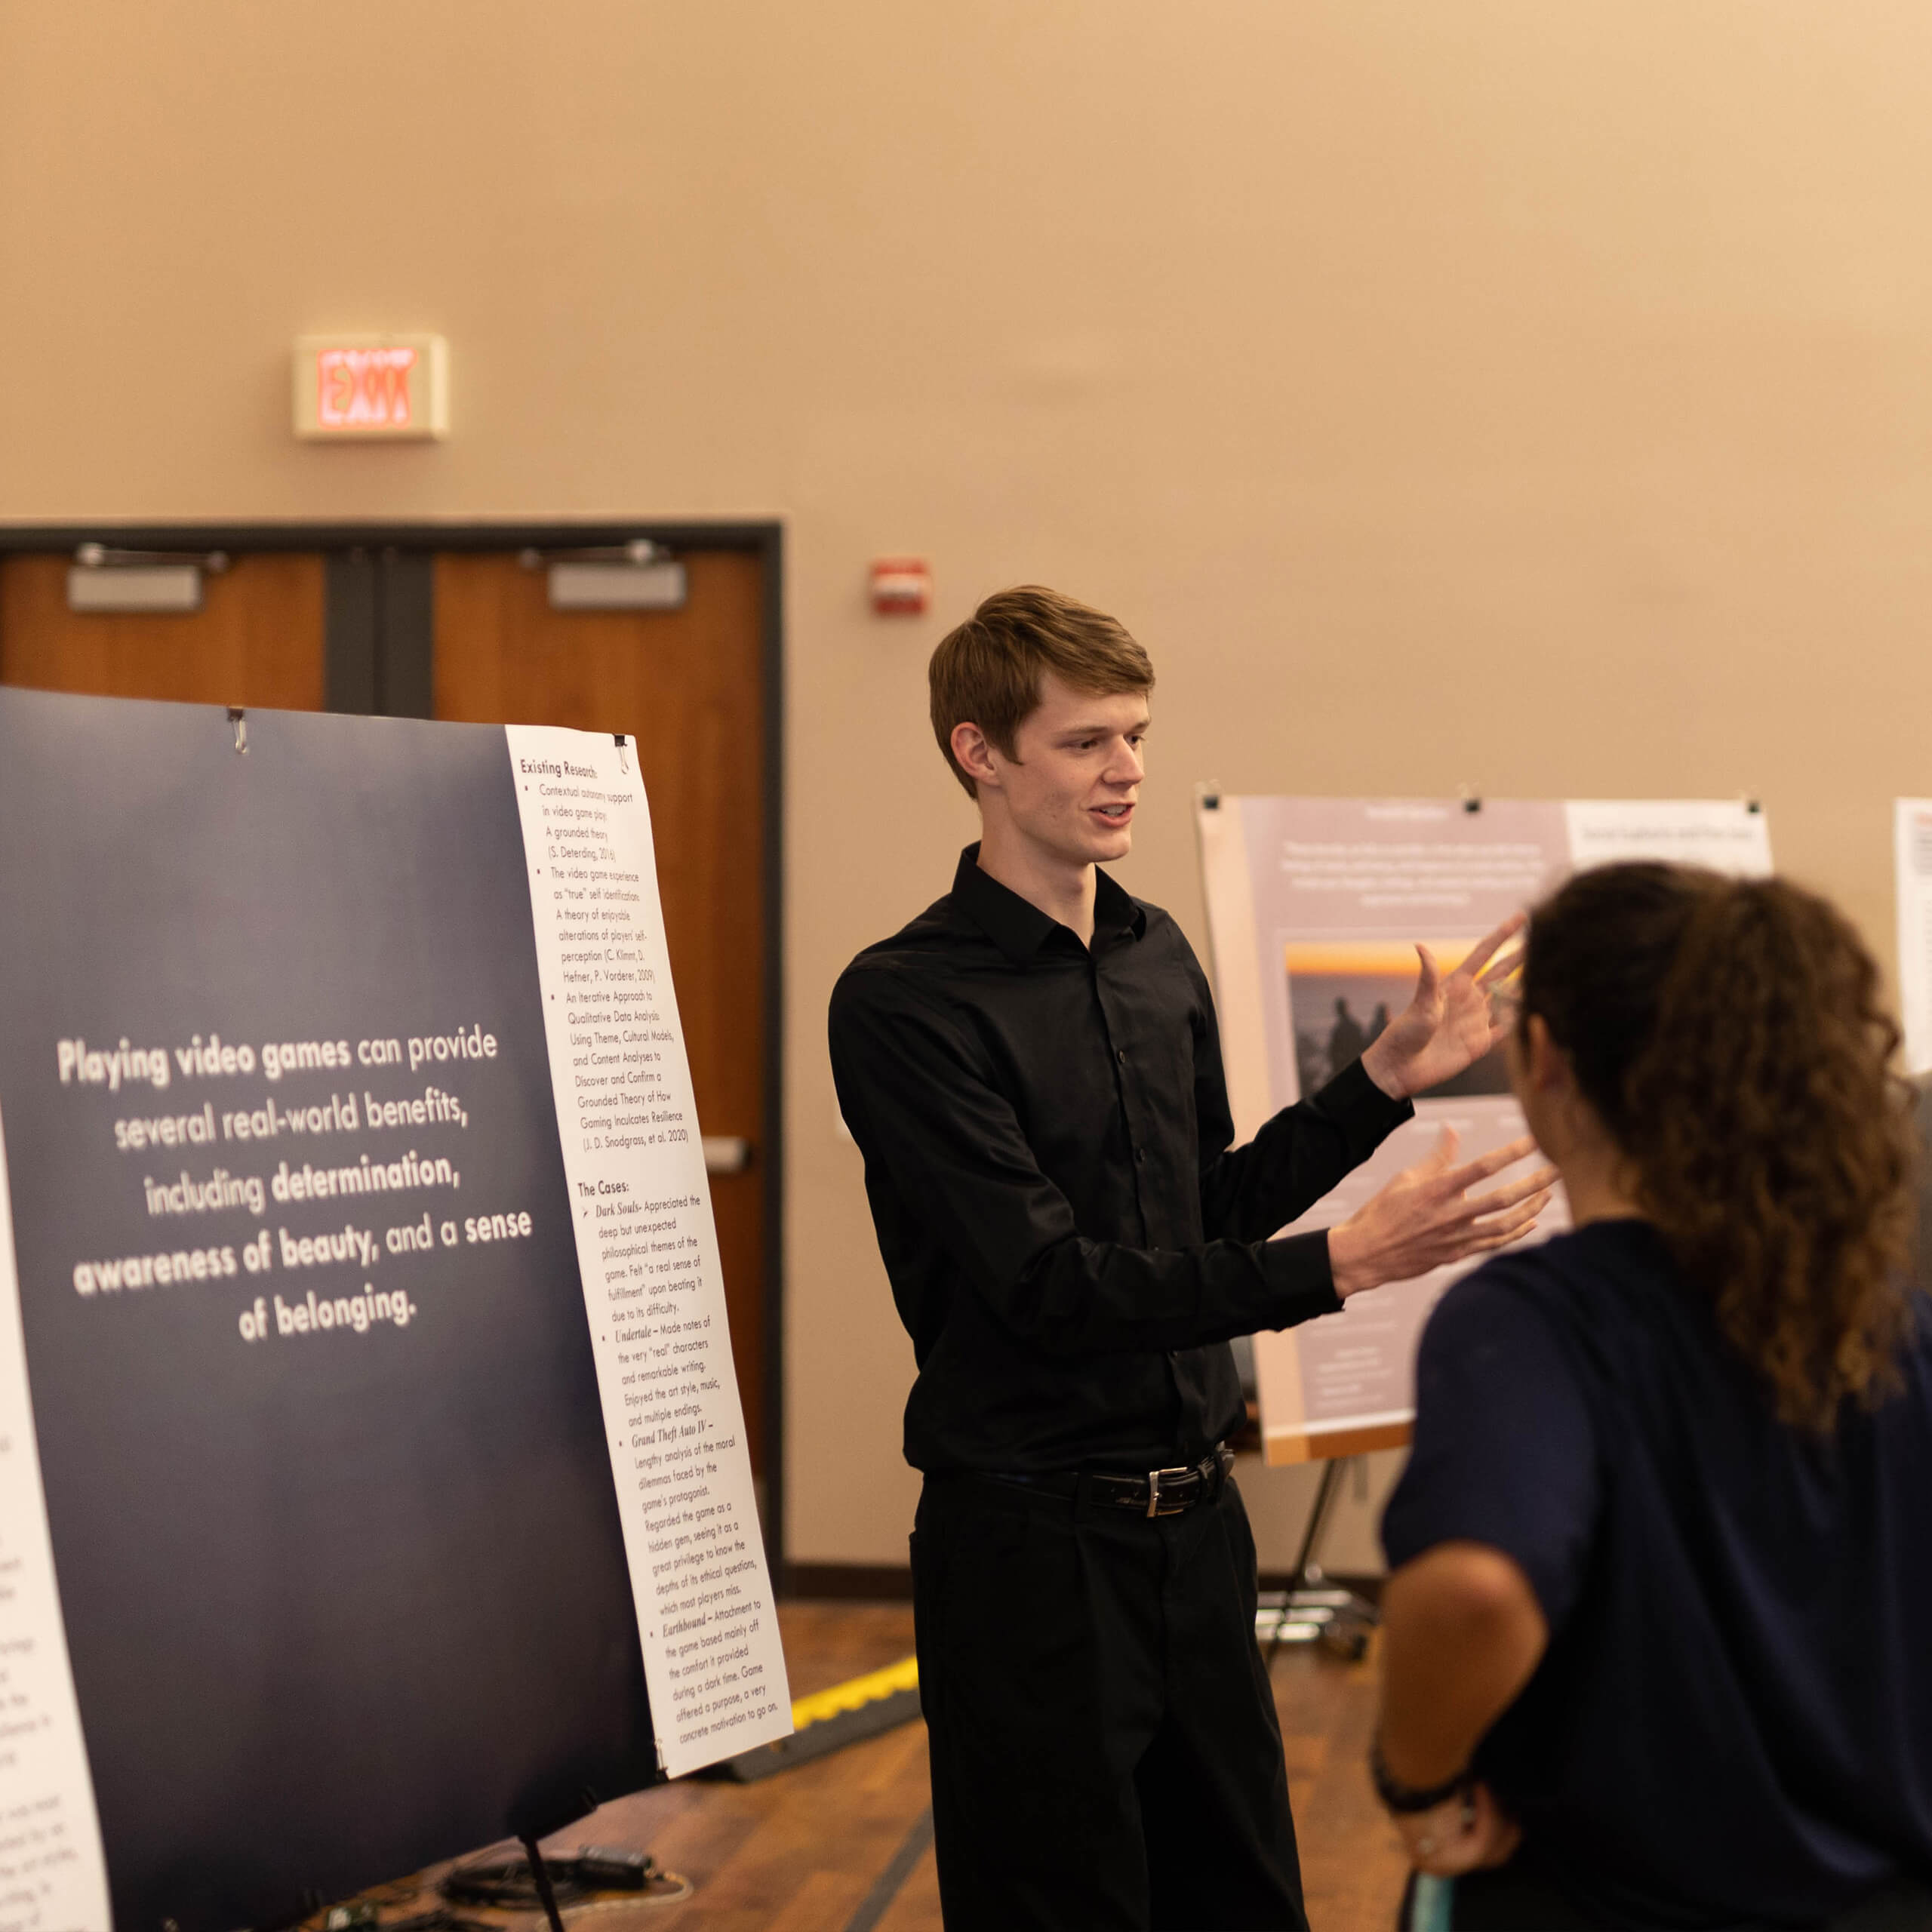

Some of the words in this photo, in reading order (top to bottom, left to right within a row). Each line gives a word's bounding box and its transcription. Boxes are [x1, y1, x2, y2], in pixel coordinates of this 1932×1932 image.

[317, 347, 418, 429] EXIT
[521, 759, 561, 777] Existing
[540, 783, 580, 797] Contextual
[608, 793, 633, 805] support
[552, 805, 573, 817] video
[575, 810, 592, 820] game
[546, 826, 552, 837] A
[555, 826, 589, 840] grounded
[551, 867, 565, 878] The
[568, 868, 588, 878] video
[590, 871, 608, 881] game
[589, 888, 601, 900] self
[556, 909, 562, 920] A
[565, 909, 589, 922] theory
[559, 930, 598, 941] alterations
[561, 950, 602, 964] perception
[567, 993, 576, 1003] An
[579, 991, 610, 1002] Iterative
[568, 1012, 611, 1024] Qualitative
[614, 1011, 632, 1022] Data
[570, 1033, 592, 1047] Using
[623, 1029, 649, 1042] Cultural
[58, 1037, 170, 1091] Playing
[175, 1034, 255, 1077] video
[262, 1039, 352, 1081] games
[358, 1037, 402, 1065] can
[408, 1024, 498, 1071] provide
[573, 1054, 588, 1066] and
[591, 1053, 620, 1065] Content
[623, 1051, 653, 1064] Analyses
[575, 1075, 608, 1087] Discover
[611, 1072, 625, 1084] and
[627, 1070, 655, 1083] Confirm
[577, 1094, 618, 1108] Grounded
[620, 1093, 645, 1106] Theory
[648, 1091, 654, 1103] of
[657, 1091, 671, 1101] How
[115, 1102, 217, 1150] several
[223, 1093, 359, 1140] real-world
[365, 1086, 468, 1129] benefits,
[580, 1115, 611, 1129] Gaming
[614, 1113, 649, 1125] Inculcates
[144, 1168, 266, 1216] including
[271, 1150, 460, 1202] determination,
[578, 1183, 595, 1196] The
[598, 1180, 629, 1195] Cases:
[595, 1204, 615, 1217] Dark
[645, 1195, 688, 1213] Appreciated
[690, 1195, 700, 1205] the
[598, 1226, 618, 1238] deep
[620, 1224, 632, 1236] but
[635, 1217, 676, 1235] unexpected
[72, 1244, 237, 1295] awareness
[243, 1229, 271, 1272] of
[278, 1225, 379, 1266] beauty,
[386, 1212, 434, 1254] and
[441, 1220, 458, 1247] a
[465, 1211, 533, 1244] sense
[651, 1241, 675, 1252] themes
[677, 1236, 685, 1248] of
[687, 1237, 697, 1247] the
[629, 1263, 642, 1277] Felt
[657, 1260, 670, 1273] real
[673, 1260, 691, 1270] sense
[694, 1255, 701, 1267] of
[648, 1283, 666, 1298] upon
[669, 1278, 695, 1291] beating
[238, 1298, 267, 1341] of
[273, 1283, 417, 1335] belonging.
[612, 1309, 625, 1322] due
[615, 1327, 651, 1343] Undertale
[660, 1321, 681, 1335] Made
[683, 1320, 701, 1331] notes
[703, 1315, 711, 1327] of
[632, 1351, 647, 1362] very
[622, 1372, 635, 1385] and
[638, 1365, 678, 1381] remarkable
[624, 1391, 653, 1407] Enjoyed
[669, 1386, 678, 1397] art
[628, 1416, 641, 1427] and
[645, 1410, 671, 1424] multiple
[632, 1428, 655, 1447] Grand
[657, 1426, 677, 1442] Theft
[679, 1423, 696, 1438] Auto
[698, 1420, 706, 1432] IV
[665, 1447, 692, 1462] analysis
[716, 1435, 735, 1450] moral
[673, 1466, 694, 1481] faced
[695, 1465, 704, 1478] by
[645, 1515, 680, 1532] Regarded
[696, 1507, 715, 1521] game
[694, 1526, 716, 1541] seeing
[653, 1561, 672, 1577] great
[674, 1553, 704, 1570] privilege
[715, 1544, 733, 1556] know
[700, 1566, 722, 1582] ethical
[680, 1598, 695, 1611] most
[698, 1590, 724, 1607] players
[663, 1612, 706, 1637] Earthbound
[715, 1604, 752, 1621] Attachment
[679, 1641, 699, 1657] game
[700, 1634, 723, 1649] based
[724, 1626, 746, 1641] mainly
[749, 1619, 759, 1632] off
[682, 1659, 709, 1676] comfort
[718, 1644, 749, 1666] provided
[672, 1687, 695, 1701] during
[705, 1677, 721, 1690] dark
[741, 1664, 763, 1678] Game
[676, 1704, 703, 1722] offered
[751, 1684, 766, 1697] very
[680, 1726, 709, 1744] concrete
[711, 1713, 746, 1730] motivation
[757, 1706, 766, 1718] go
